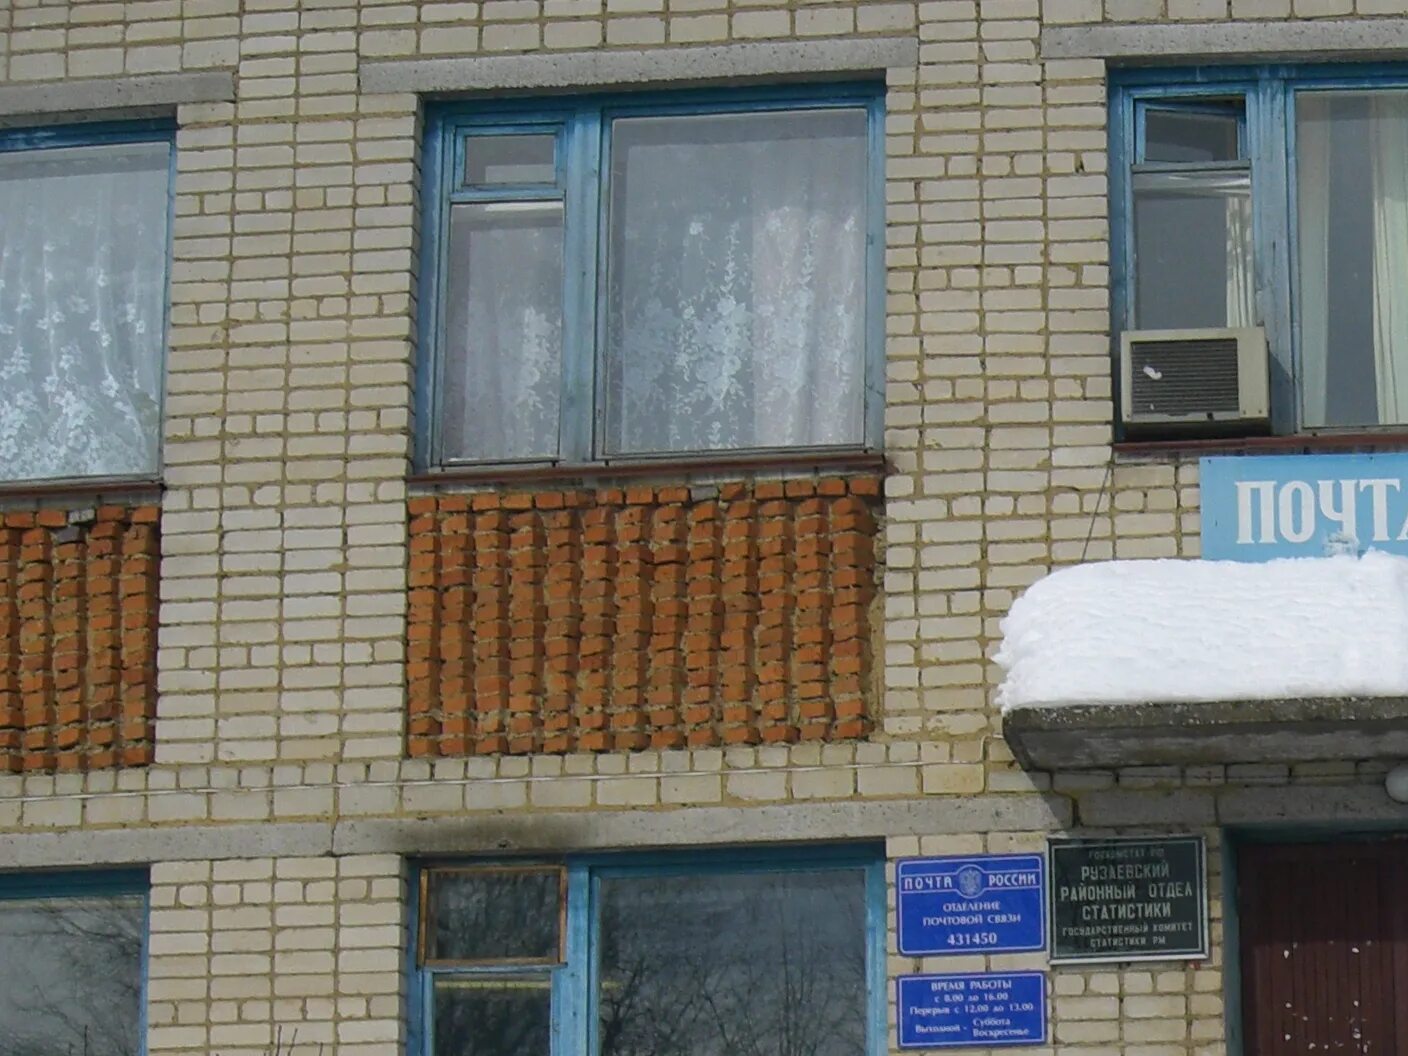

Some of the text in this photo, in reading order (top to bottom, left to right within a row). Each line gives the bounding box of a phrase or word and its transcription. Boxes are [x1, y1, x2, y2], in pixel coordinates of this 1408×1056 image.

[1081, 860, 1170, 881] РУЗАЕВСКИЙ
[904, 873, 1037, 890] ПОЧТА РОССИИ
[1060, 882, 1193, 902] РАЙОННЫЙ ОТДЕЛ
[943, 901, 1001, 912] ОТДЕЛЕНИЕ
[1082, 902, 1171, 920] СТАТИСТИКИ
[922, 913, 1022, 927] ПОЧТОВОЙ СВЯЗИ
[1062, 922, 1193, 937] ГОСУДАРСТВЕННЫЙ КОМИТЕТ
[947, 932, 998, 946] 431450
[1090, 936, 1166, 948] СТАТИСТИКИ РМ
[931, 980, 1012, 992] ВРЕМЯ РАБОТЫ
[944, 994, 964, 1002] 8.00
[984, 992, 1009, 1001] 16.00
[909, 1006, 950, 1017] Перерыв
[964, 1004, 989, 1013] 12.00
[1009, 1003, 1034, 1012] 13.00
[915, 1024, 961, 1033] Выходной
[972, 1018, 1011, 1027] Суббота
[972, 1028, 1030, 1038] Воскресенье
